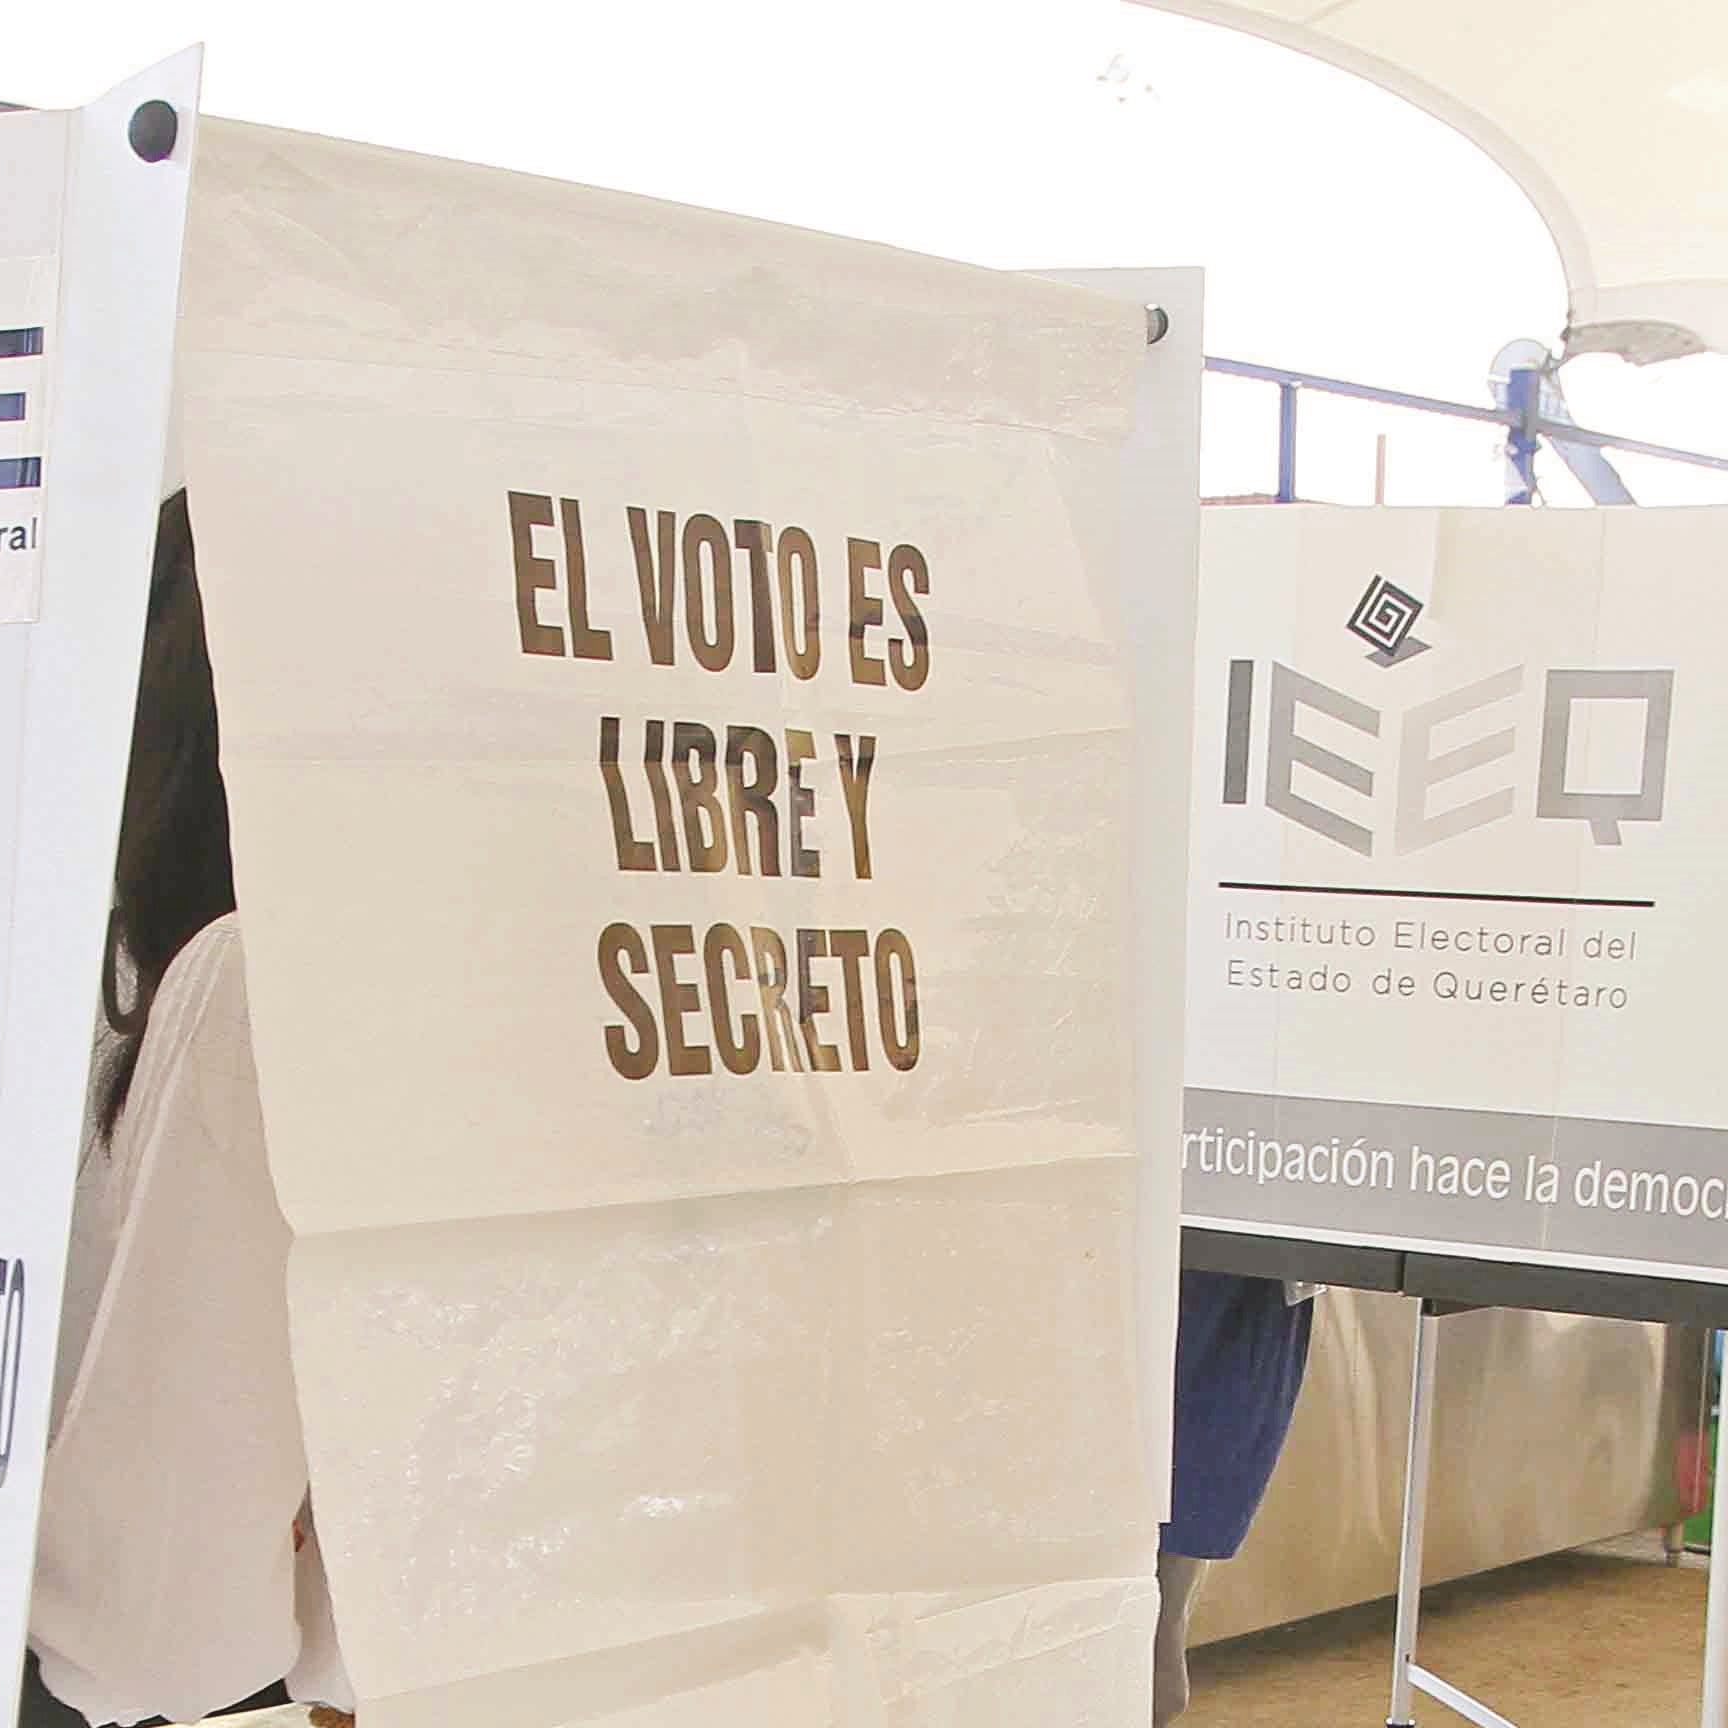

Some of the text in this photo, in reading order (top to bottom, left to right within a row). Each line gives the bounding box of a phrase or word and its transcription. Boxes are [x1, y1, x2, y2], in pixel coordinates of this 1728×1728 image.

[508, 490, 929, 692] EL VOTO ES
[600, 716, 876, 880] LIBRE Y
[1223, 658, 1674, 858] IEEQ
[597, 922, 920, 1081] SECRETO
[1225, 912, 1638, 962] Instituto Electoral del
[1226, 960, 1628, 1010] Estado de Querétaro
[1181, 1127, 1395, 1189] rticipación
[1410, 1145, 1511, 1199] hace
[1524, 1155, 1559, 1204] la
